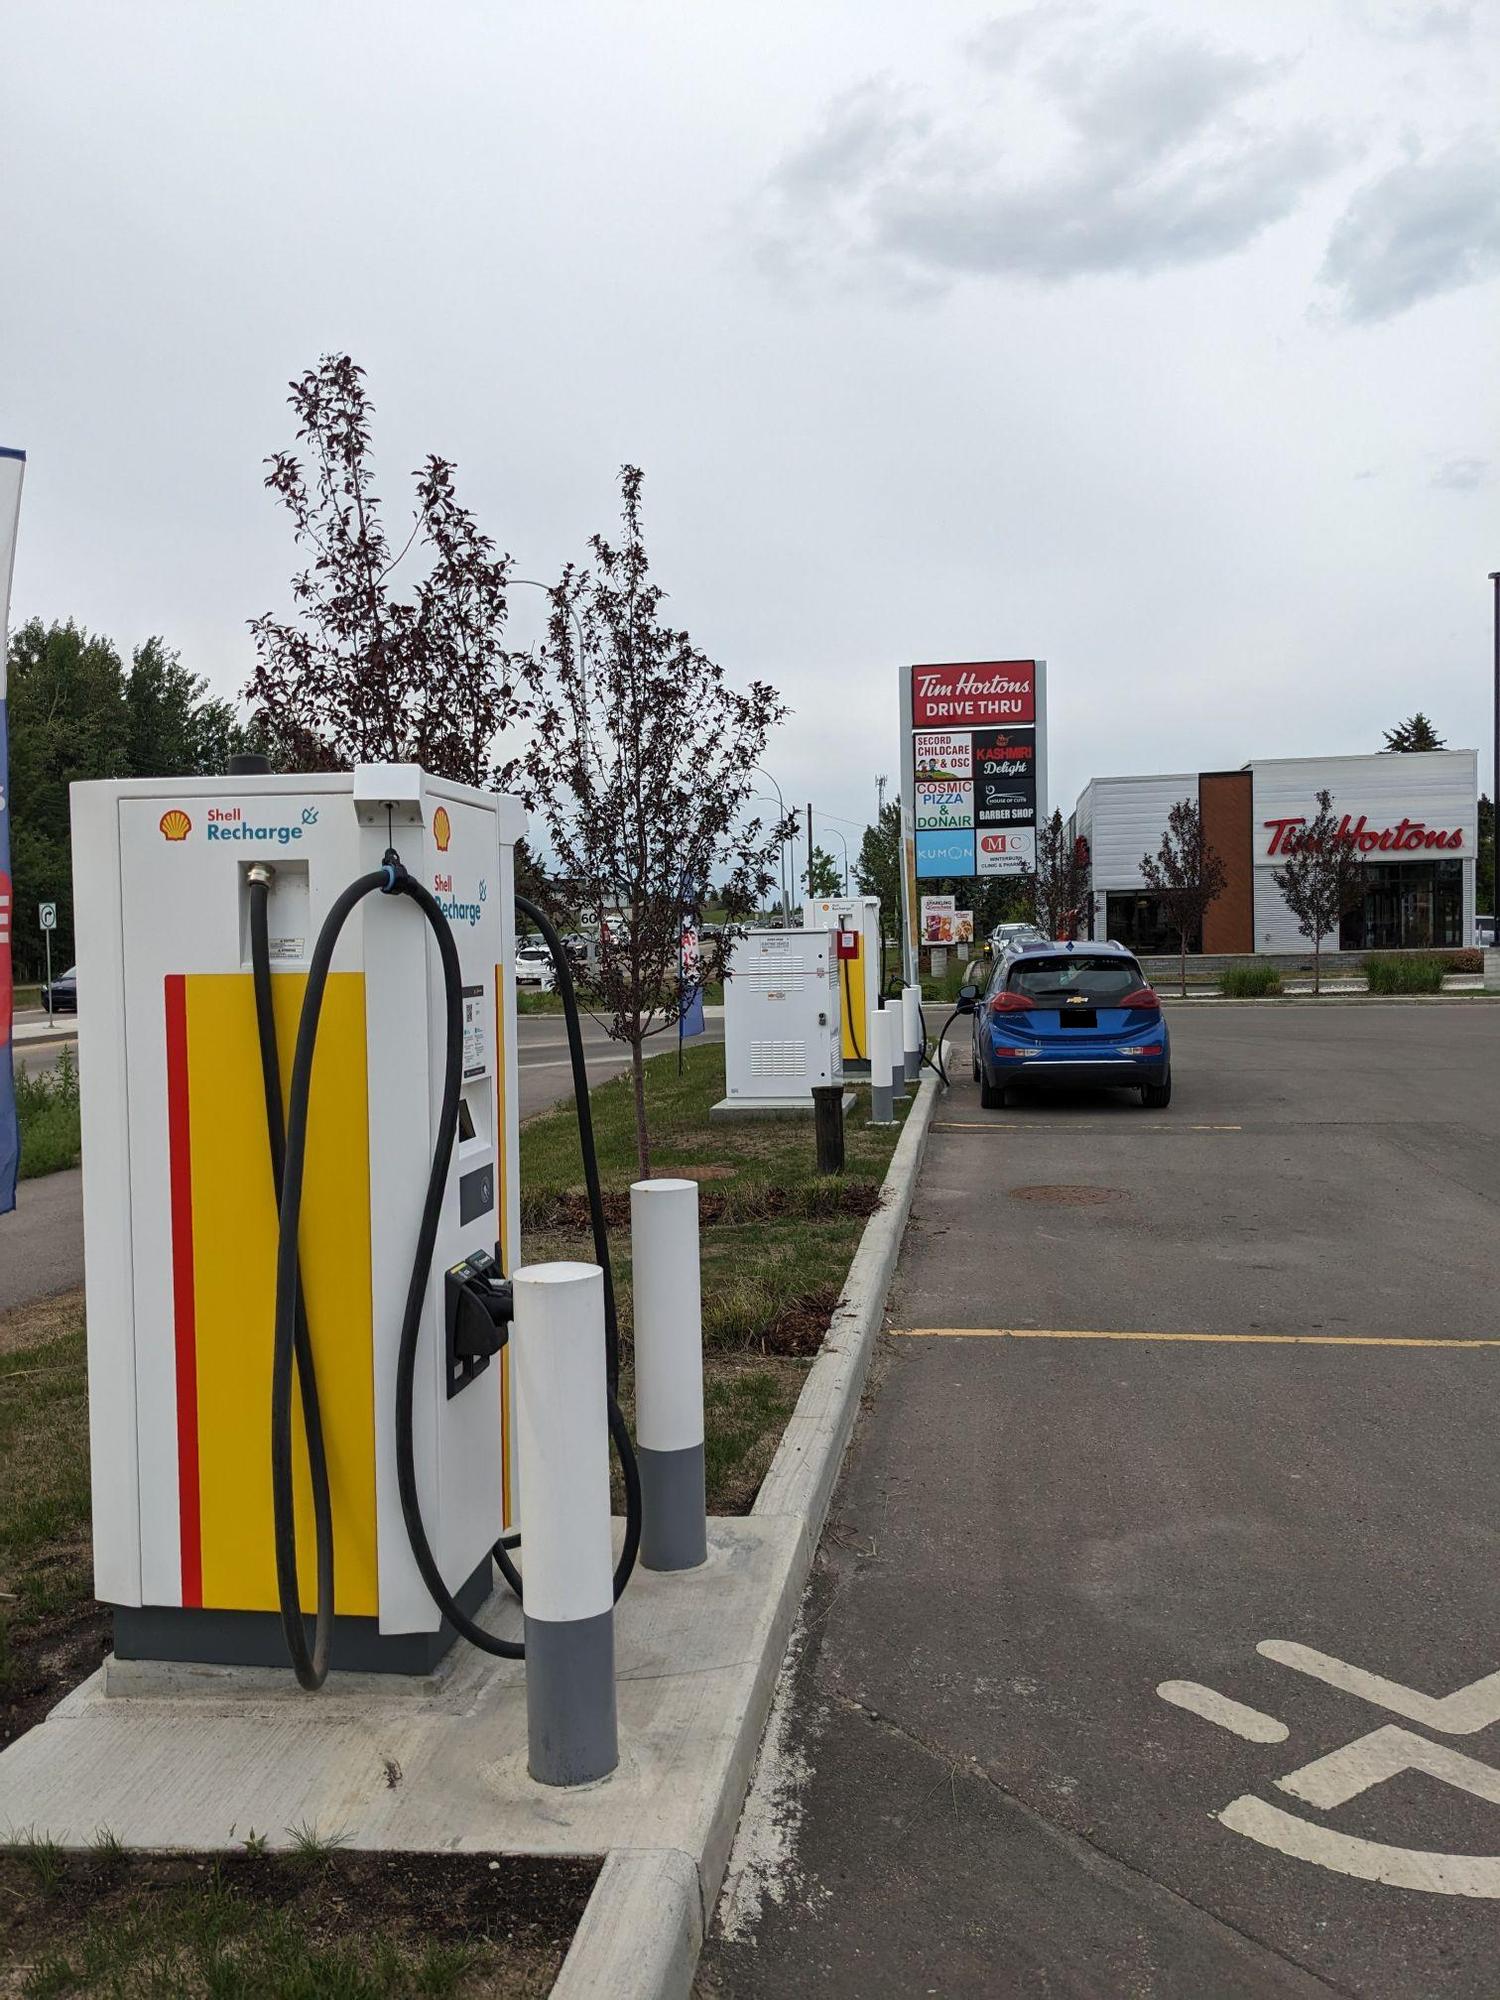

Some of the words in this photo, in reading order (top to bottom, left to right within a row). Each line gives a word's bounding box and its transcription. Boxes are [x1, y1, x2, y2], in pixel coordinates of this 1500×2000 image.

[917, 674, 952, 697] Tim
[956, 672, 1030, 696] Hortons
[926, 702, 974, 717] DRIVE
[978, 700, 1022, 714] THRU
[917, 736, 952, 746] SECORD
[917, 745, 970, 757] CHILDCARE
[976, 746, 1032, 761] KASHMIRI
[940, 758, 948, 769] &
[950, 757, 970, 768] OSC
[983, 761, 1027, 776] Delight
[917, 782, 972, 795] COSMIC
[923, 794, 964, 805] PIZZA
[207, 809, 241, 821] Shell
[939, 805, 949, 816] &
[979, 809, 1010, 820] BARBER
[1011, 808, 1034, 819] SHOP
[917, 815, 972, 828] DONAIR
[207, 824, 303, 844] Recharge
[1332, 814, 1464, 851] Hortons
[918, 847, 973, 860] KUMON
[434, 873, 452, 892] Shell
[581, 913, 597, 924] 60
